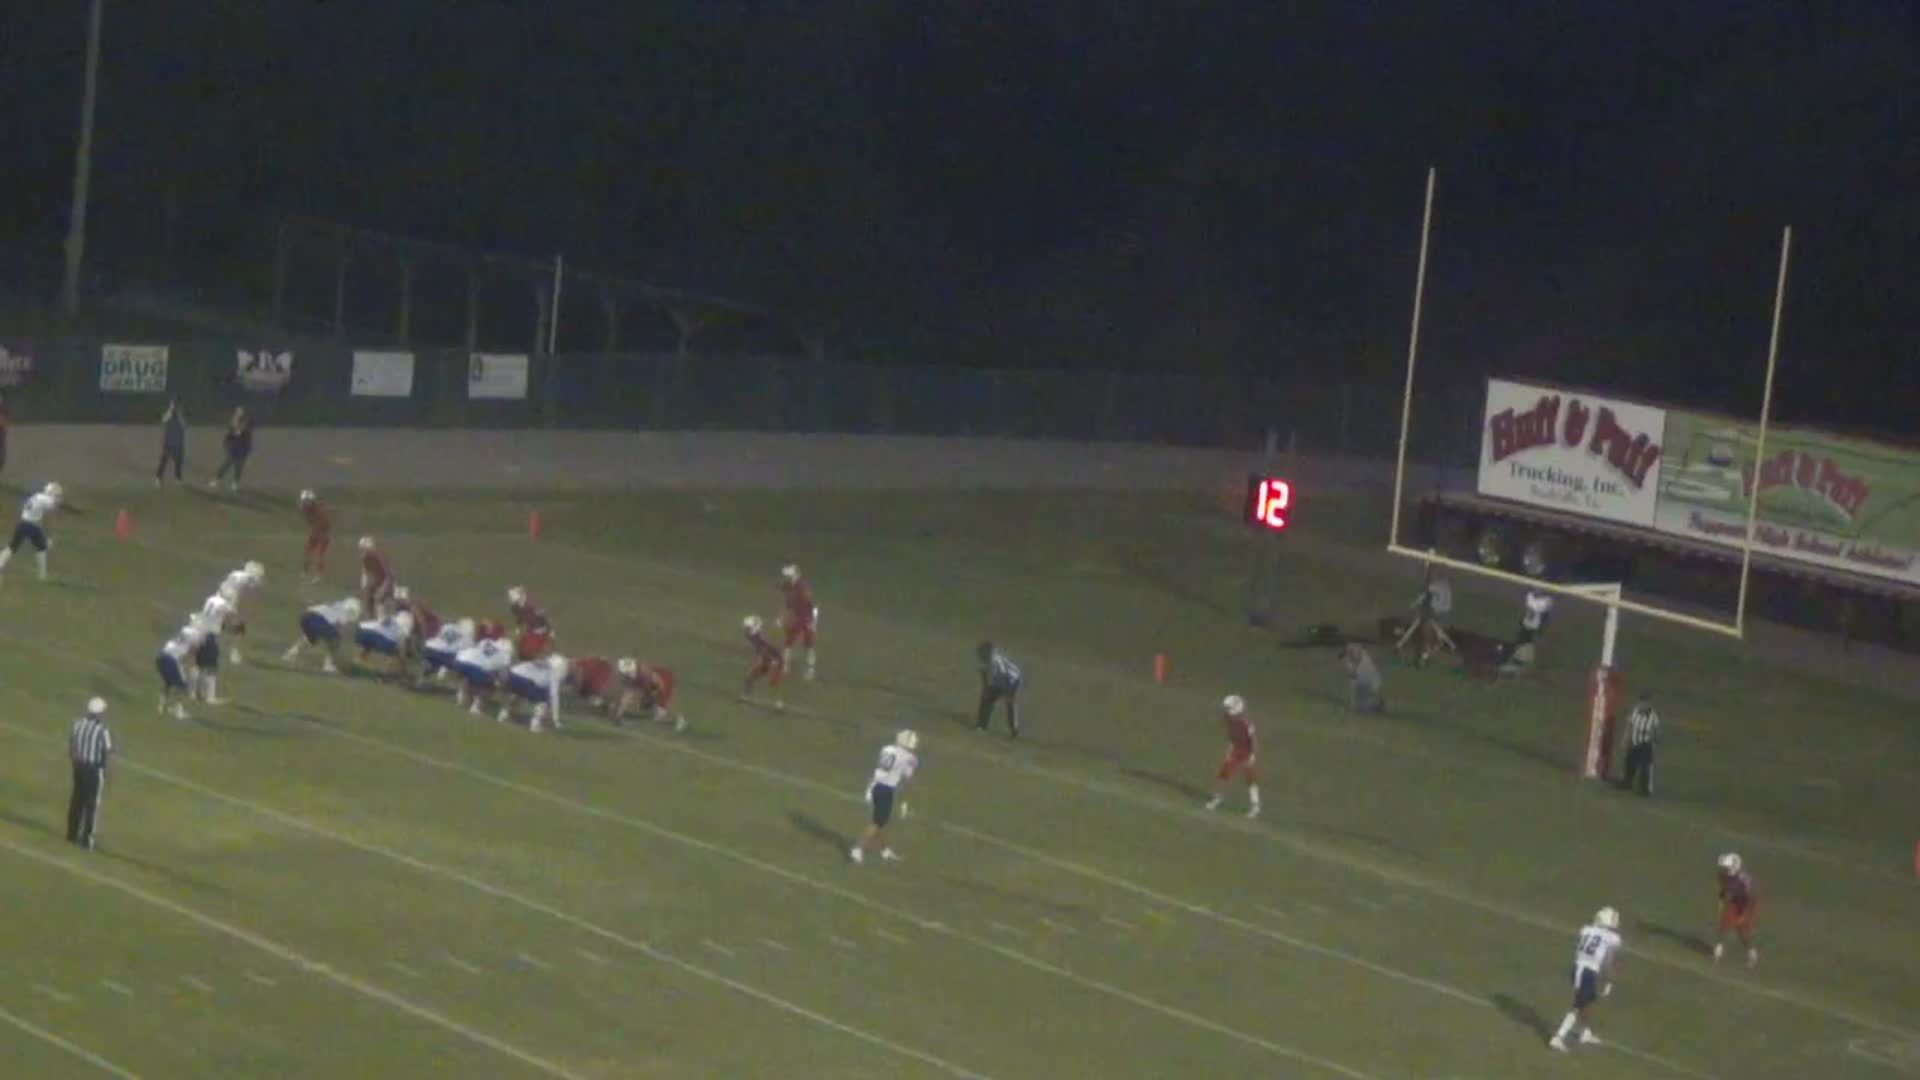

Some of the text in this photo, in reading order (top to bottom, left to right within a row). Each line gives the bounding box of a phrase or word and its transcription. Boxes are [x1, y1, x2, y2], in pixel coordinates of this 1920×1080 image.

[104, 359, 165, 376] DRUG
[1490, 394, 1561, 463] Huff
[1589, 406, 1660, 489] Puff
[1510, 462, 1588, 492] Trucking,
[1593, 477, 1626, 497] Inc.
[1257, 481, 1289, 527] 12
